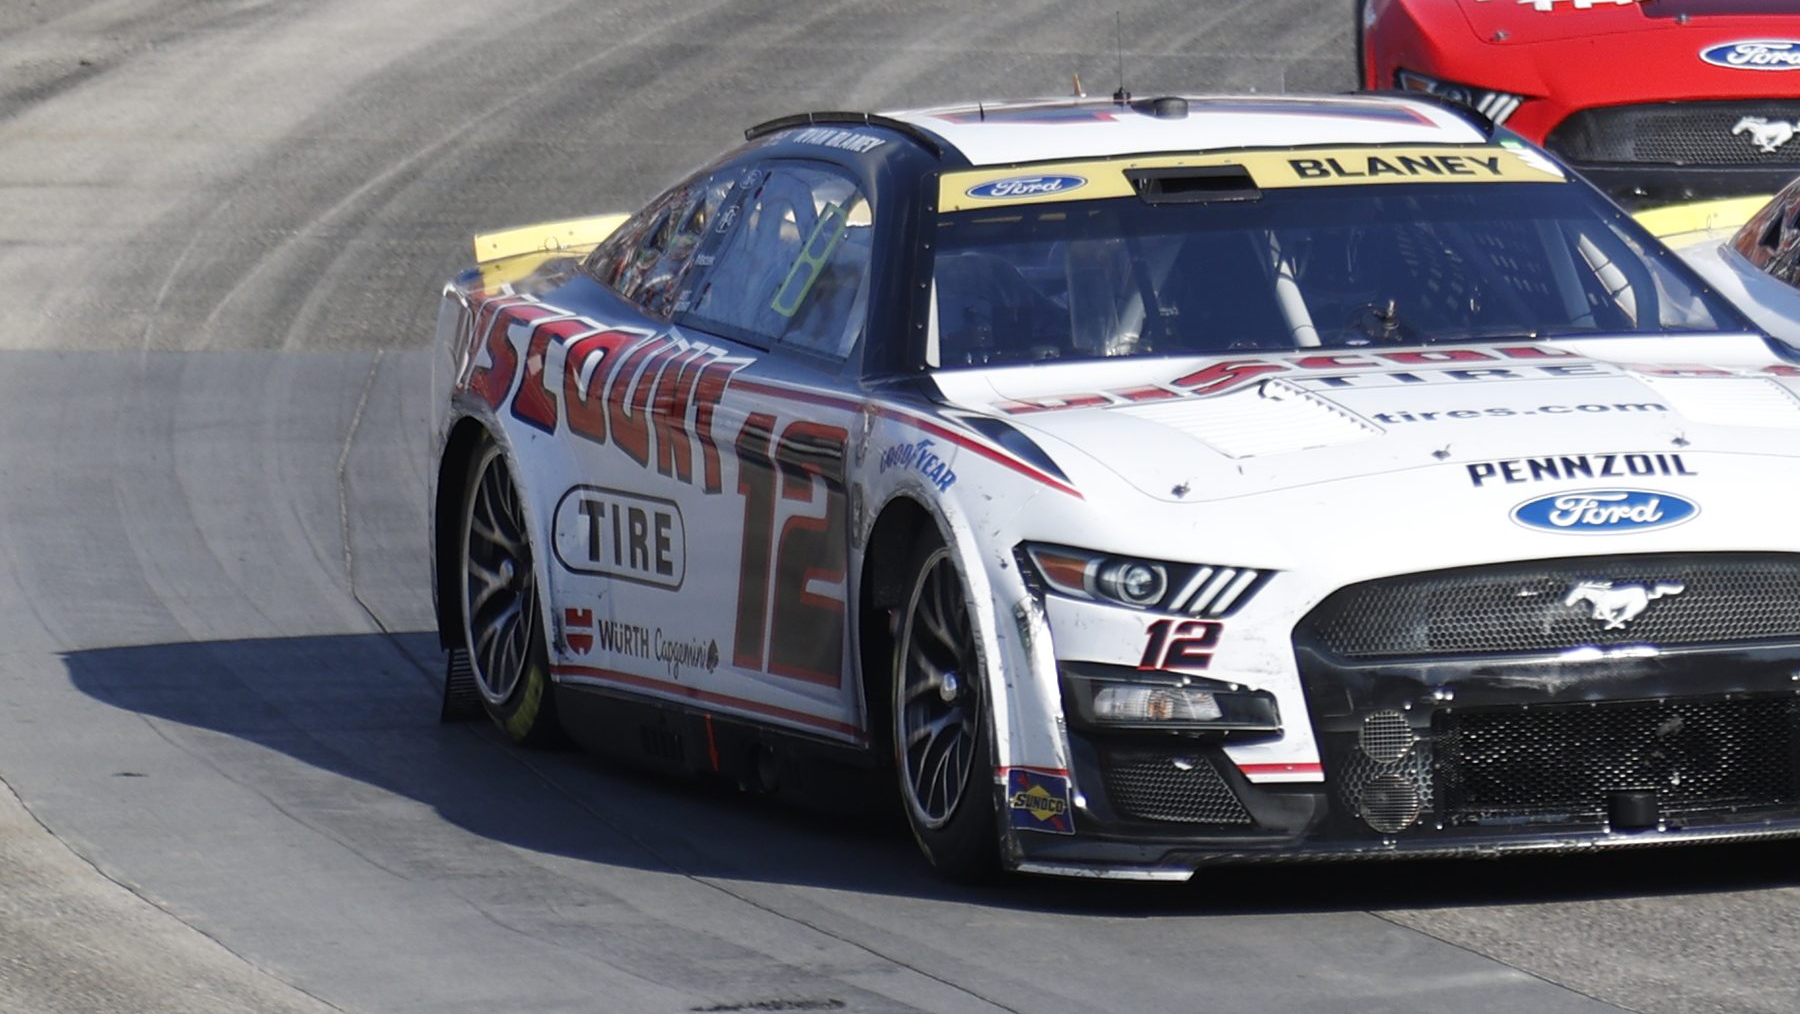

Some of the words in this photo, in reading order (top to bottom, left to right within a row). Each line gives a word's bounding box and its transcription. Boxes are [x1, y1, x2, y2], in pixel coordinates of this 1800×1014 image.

[1287, 154, 1505, 180] BLANEY
[1308, 364, 1611, 386] TIRE
[1373, 400, 1669, 425] tires.com
[1467, 452, 1700, 489] PENNZOIL
[578, 498, 675, 577] TIRE
[735, 410, 850, 691] 12
[598, 618, 650, 659] WÜRTH
[654, 626, 708, 680] Capgemini
[1138, 618, 1224, 672] 12
[1013, 792, 1065, 815] SUNOCO
